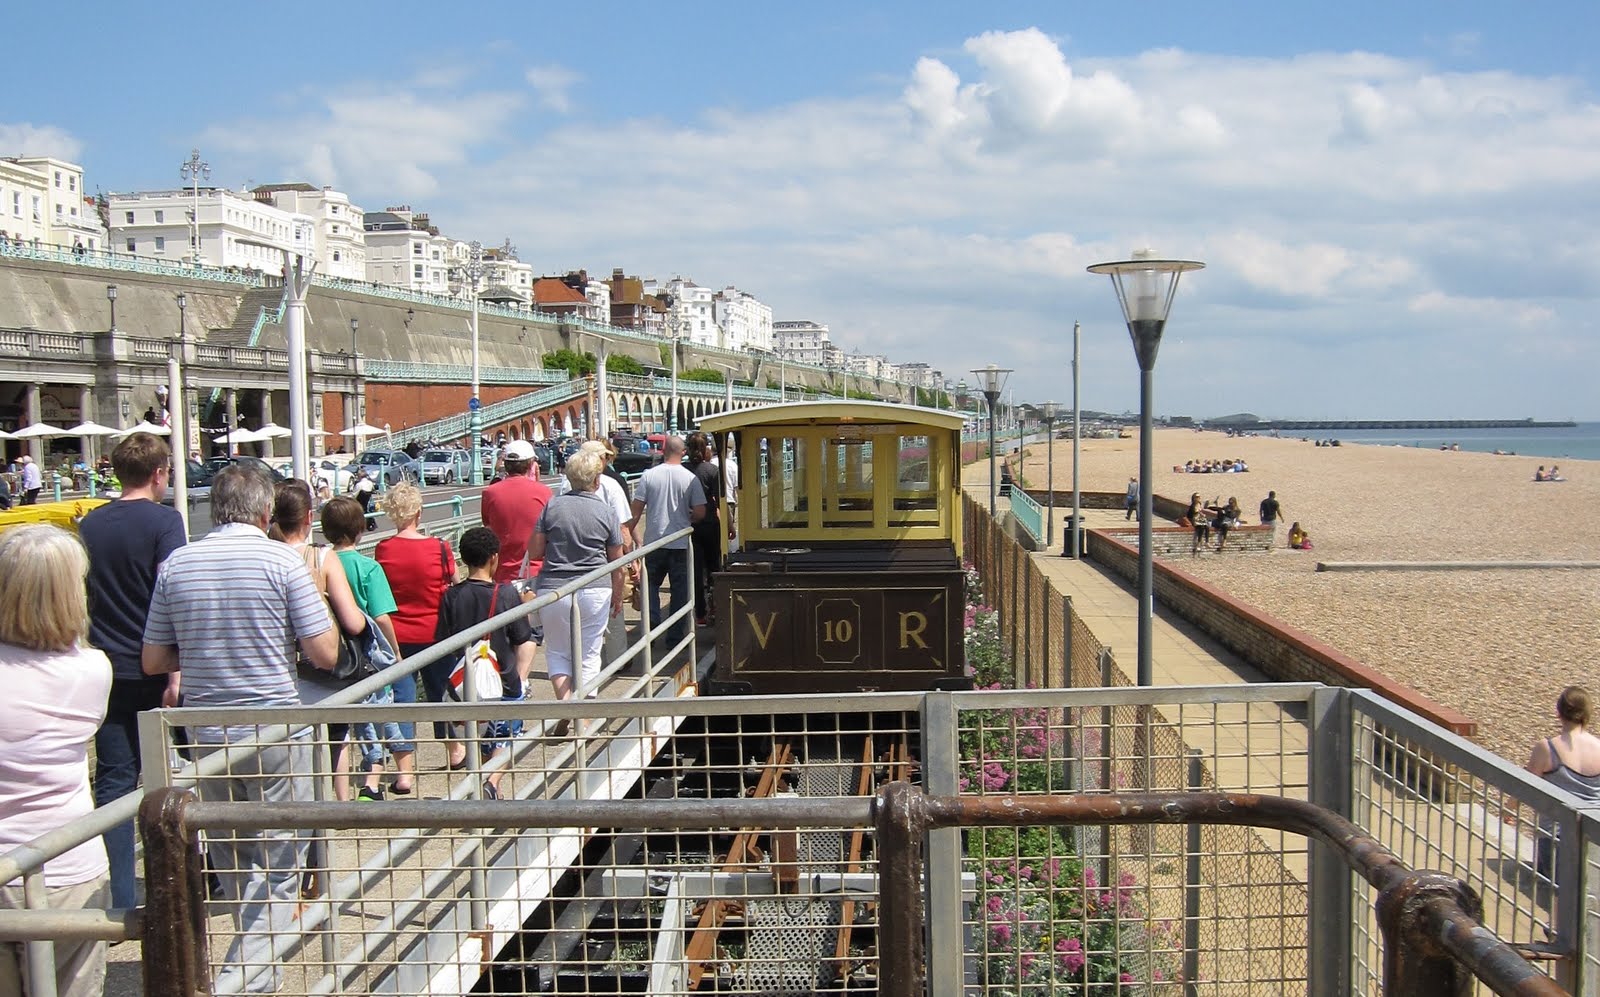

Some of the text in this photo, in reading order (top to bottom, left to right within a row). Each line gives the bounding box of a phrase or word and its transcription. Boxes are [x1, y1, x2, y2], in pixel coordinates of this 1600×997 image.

[747, 611, 931, 650] V 10 R
